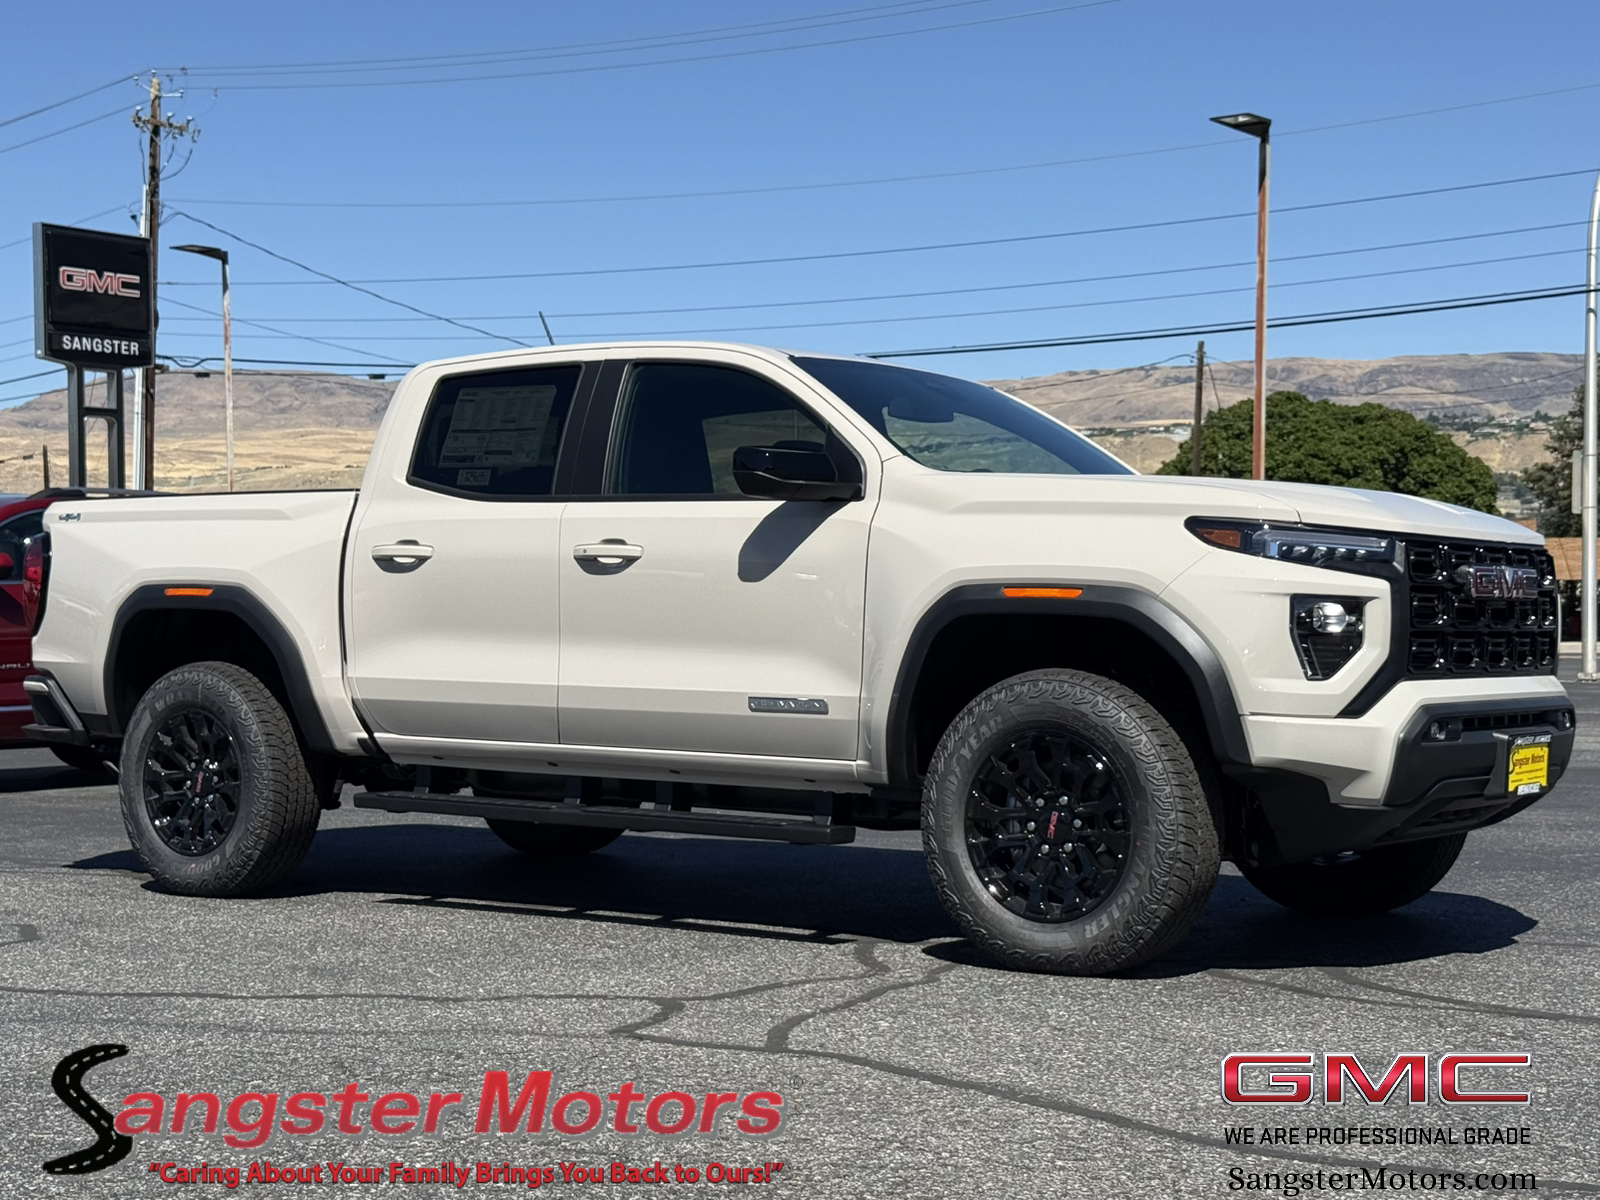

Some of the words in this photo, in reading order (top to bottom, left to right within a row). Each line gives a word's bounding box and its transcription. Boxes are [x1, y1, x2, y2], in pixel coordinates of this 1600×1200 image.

[59, 266, 141, 299] GMC
[62, 334, 140, 356] SANGSTER
[1470, 565, 1538, 598] GMC
[1046, 810, 1060, 840] GMC
